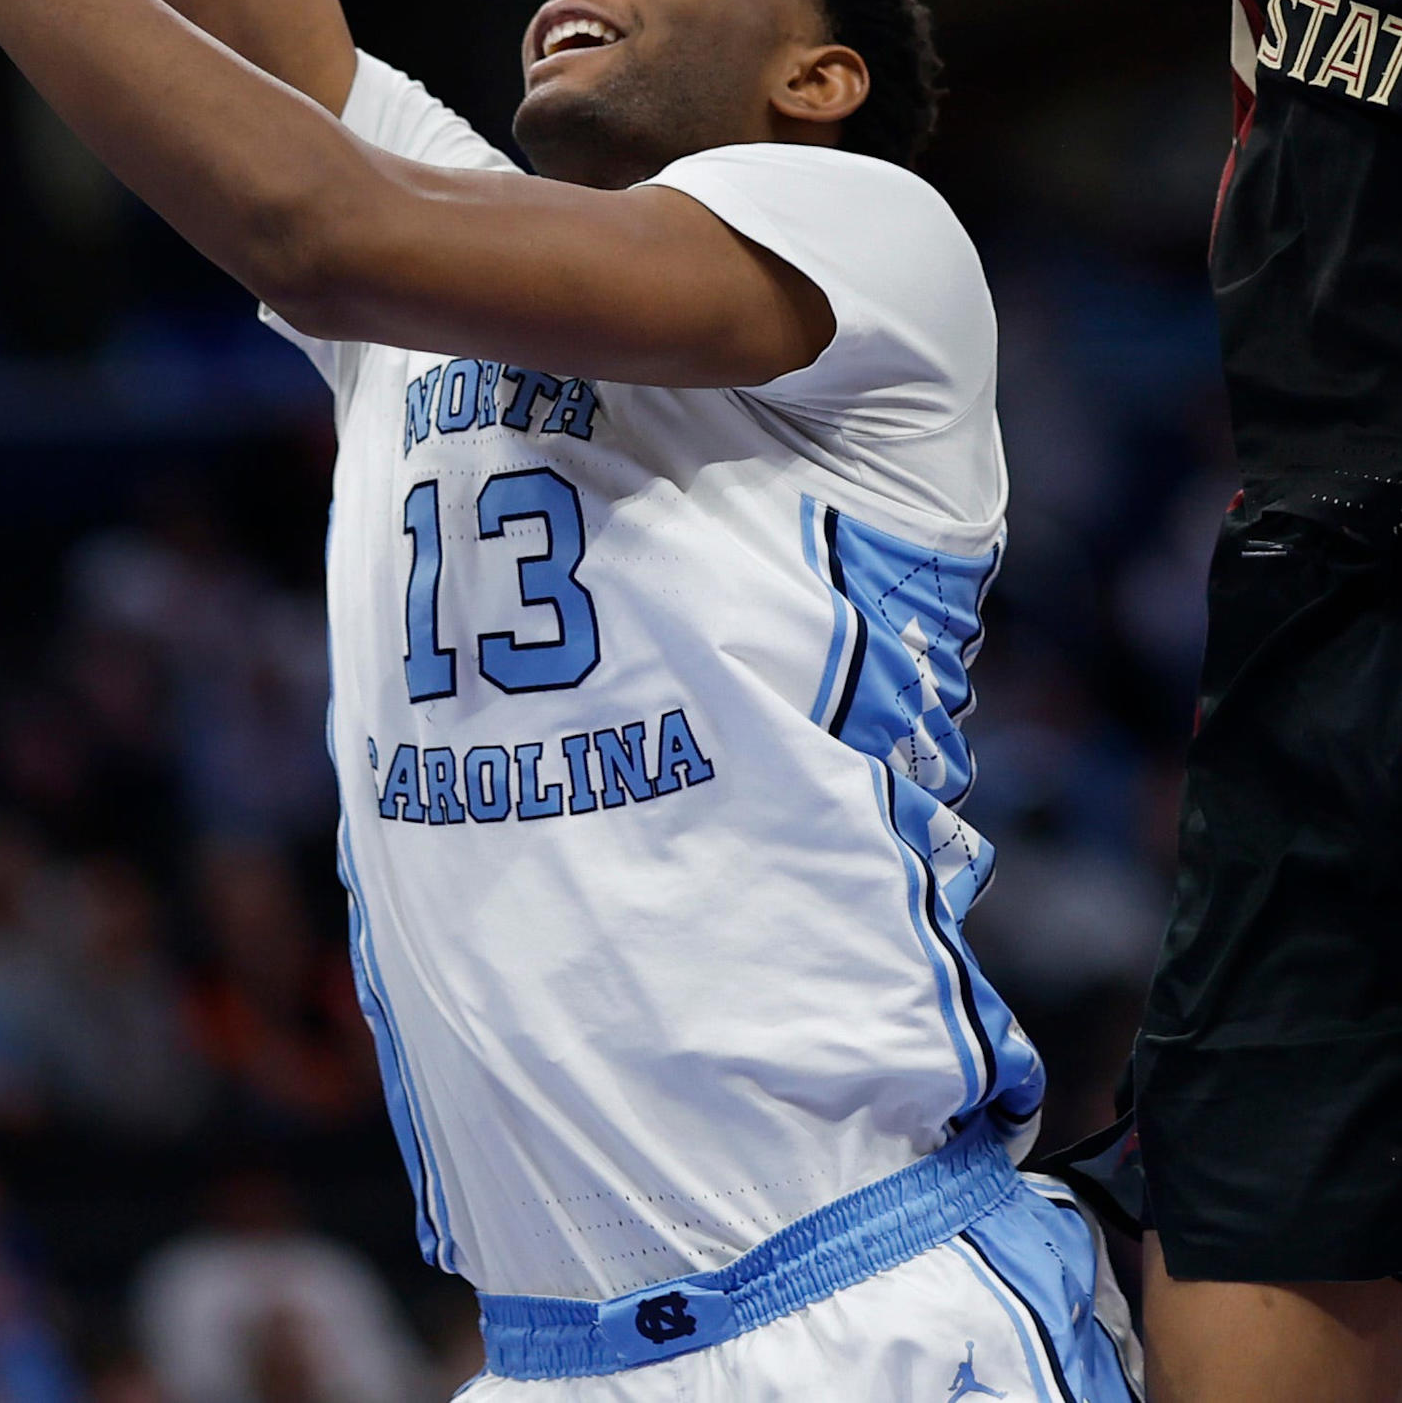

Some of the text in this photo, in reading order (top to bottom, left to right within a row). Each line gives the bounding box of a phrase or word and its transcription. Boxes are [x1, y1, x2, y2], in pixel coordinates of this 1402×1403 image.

[404, 359, 599, 460] NORTH
[404, 466, 601, 704] 13
[367, 709, 715, 826] AROLINA
